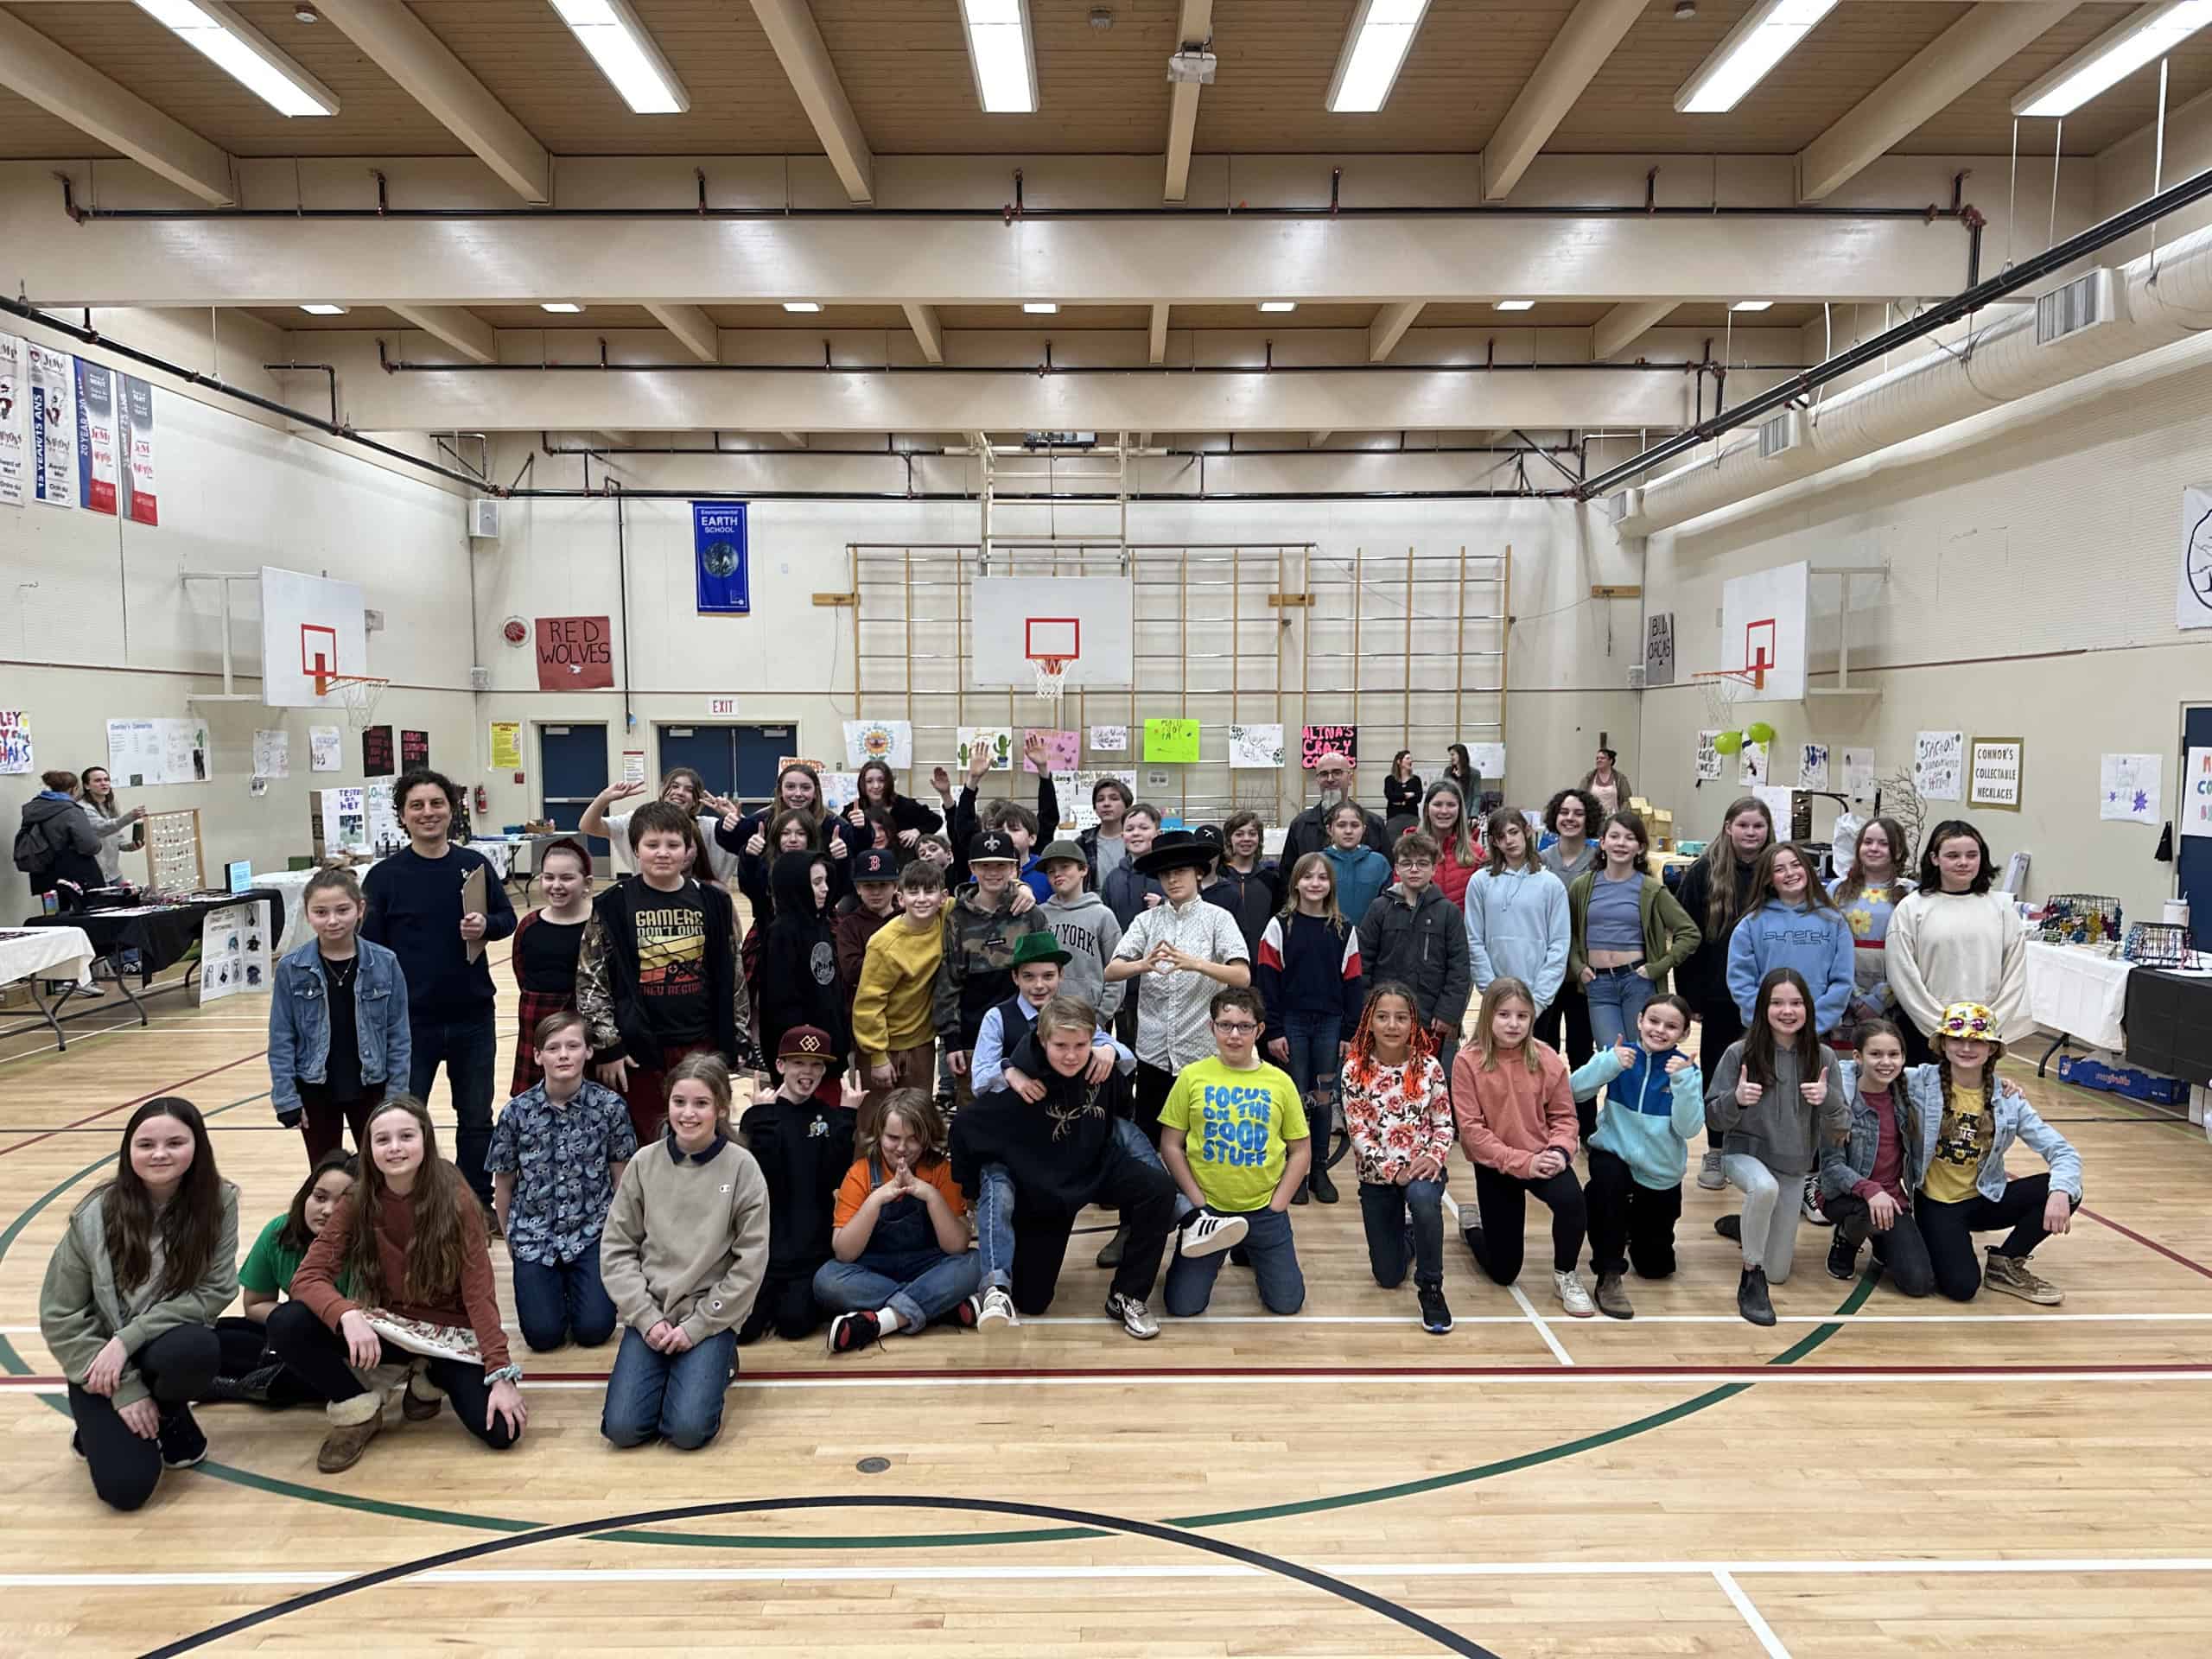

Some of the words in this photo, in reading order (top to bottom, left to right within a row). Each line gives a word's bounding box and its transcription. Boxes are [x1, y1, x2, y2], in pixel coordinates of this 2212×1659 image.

[701, 517, 738, 526] EARTH
[550, 621, 600, 643] RED
[539, 643, 611, 664] WOLVES
[713, 700, 734, 714] EXIT
[1302, 726, 1354, 741] ALINA'S
[1303, 739, 1352, 755] CRAZY
[1977, 748, 2013, 760] CONNOR'S
[1975, 768, 2016, 780] COLLECTABLE
[1976, 787, 2013, 800] NECKLACES
[1061, 924, 1095, 957] YORK
[1204, 1085, 1272, 1109] FOCUS
[1203, 1106, 1230, 1122] ON
[1236, 1101, 1271, 1123] THE
[1204, 1120, 1269, 1153] GOOD
[1203, 1139, 1268, 1167] STUFF
